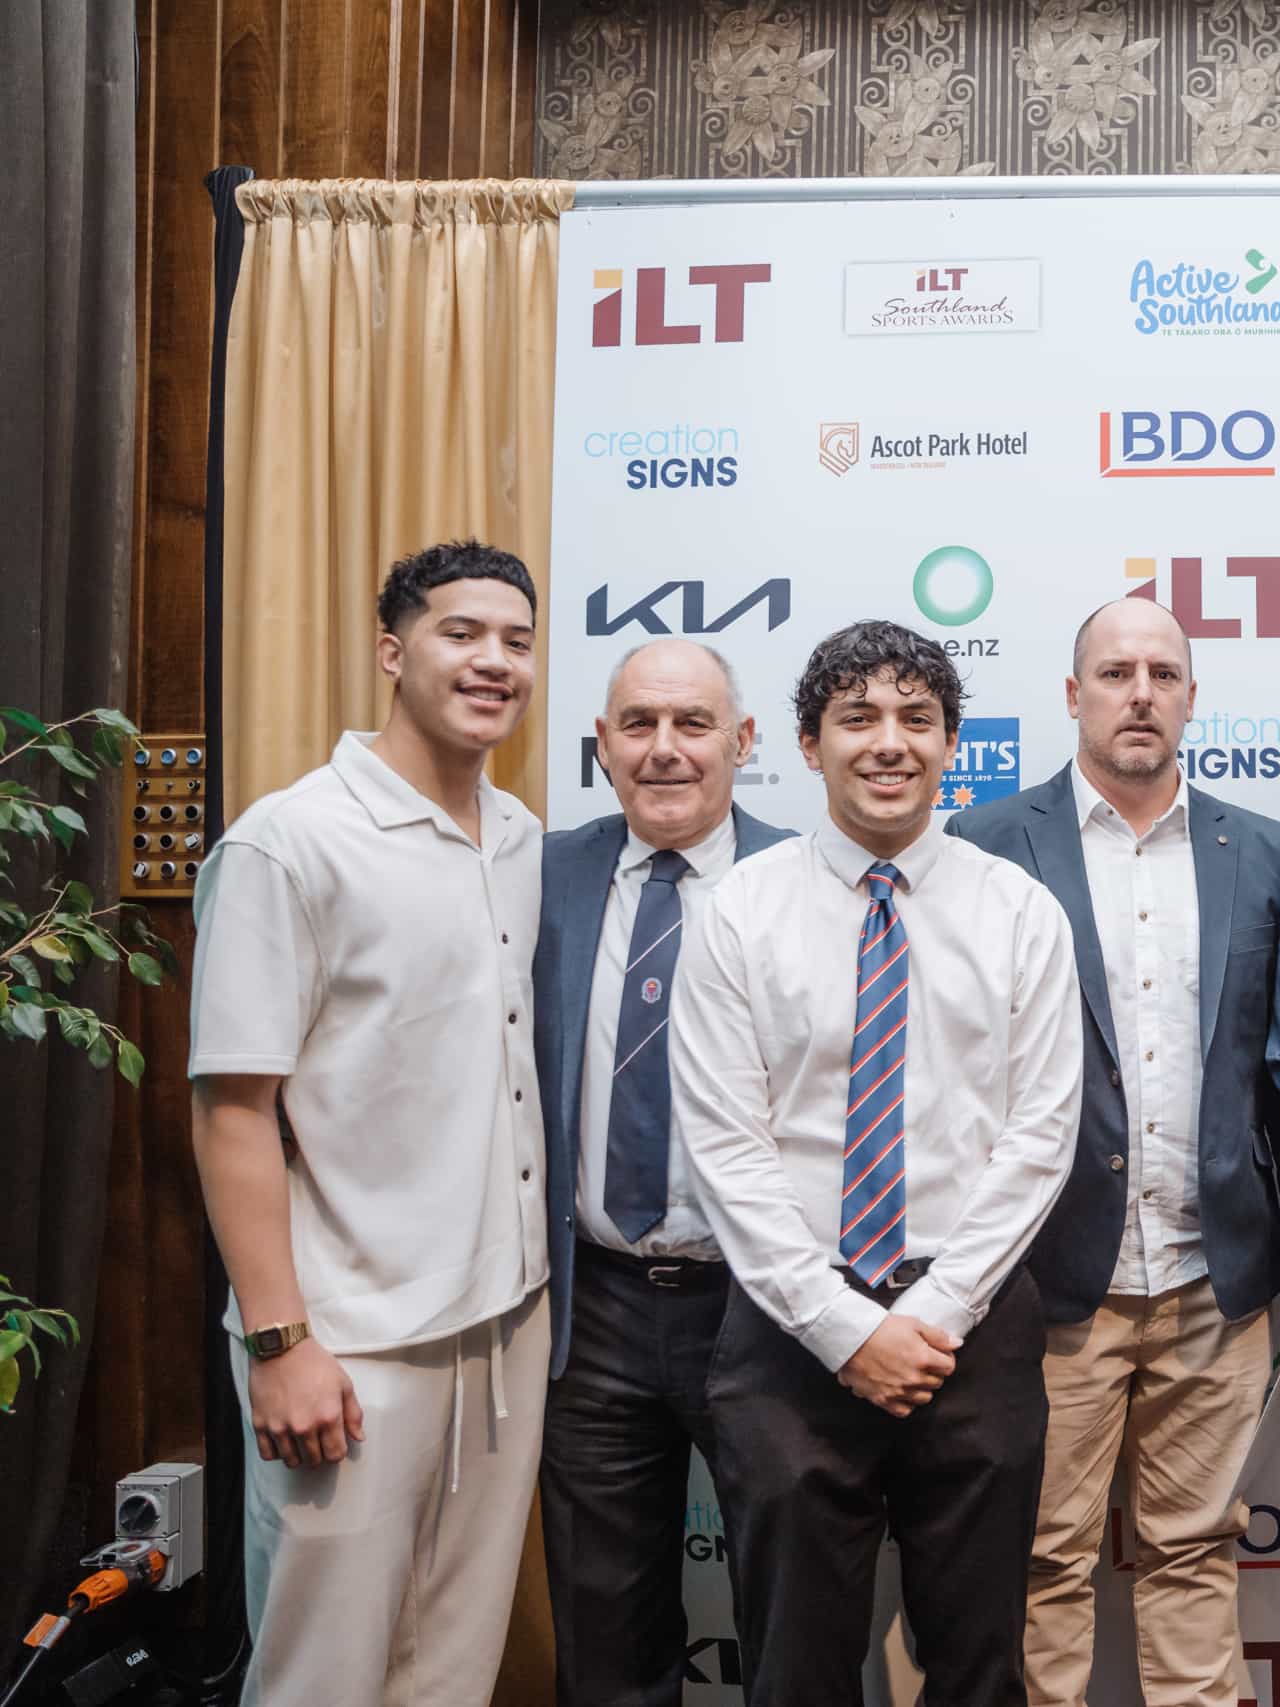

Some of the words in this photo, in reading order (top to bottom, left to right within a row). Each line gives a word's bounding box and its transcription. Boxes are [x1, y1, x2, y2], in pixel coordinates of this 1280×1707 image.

[1130, 259, 1240, 302] Active
[872, 313, 936, 328] SPORTS
[941, 310, 1014, 326] AWARDS
[884, 296, 1008, 317] Southland
[583, 423, 739, 458] creation
[870, 435, 922, 458] Ascot
[928, 432, 970, 457] Park
[977, 431, 1027, 455] Hotel
[1121, 409, 1276, 462] BDO
[626, 455, 739, 490] SIGNS
[943, 638, 1000, 657] e.nz
[1184, 712, 1280, 744] ation
